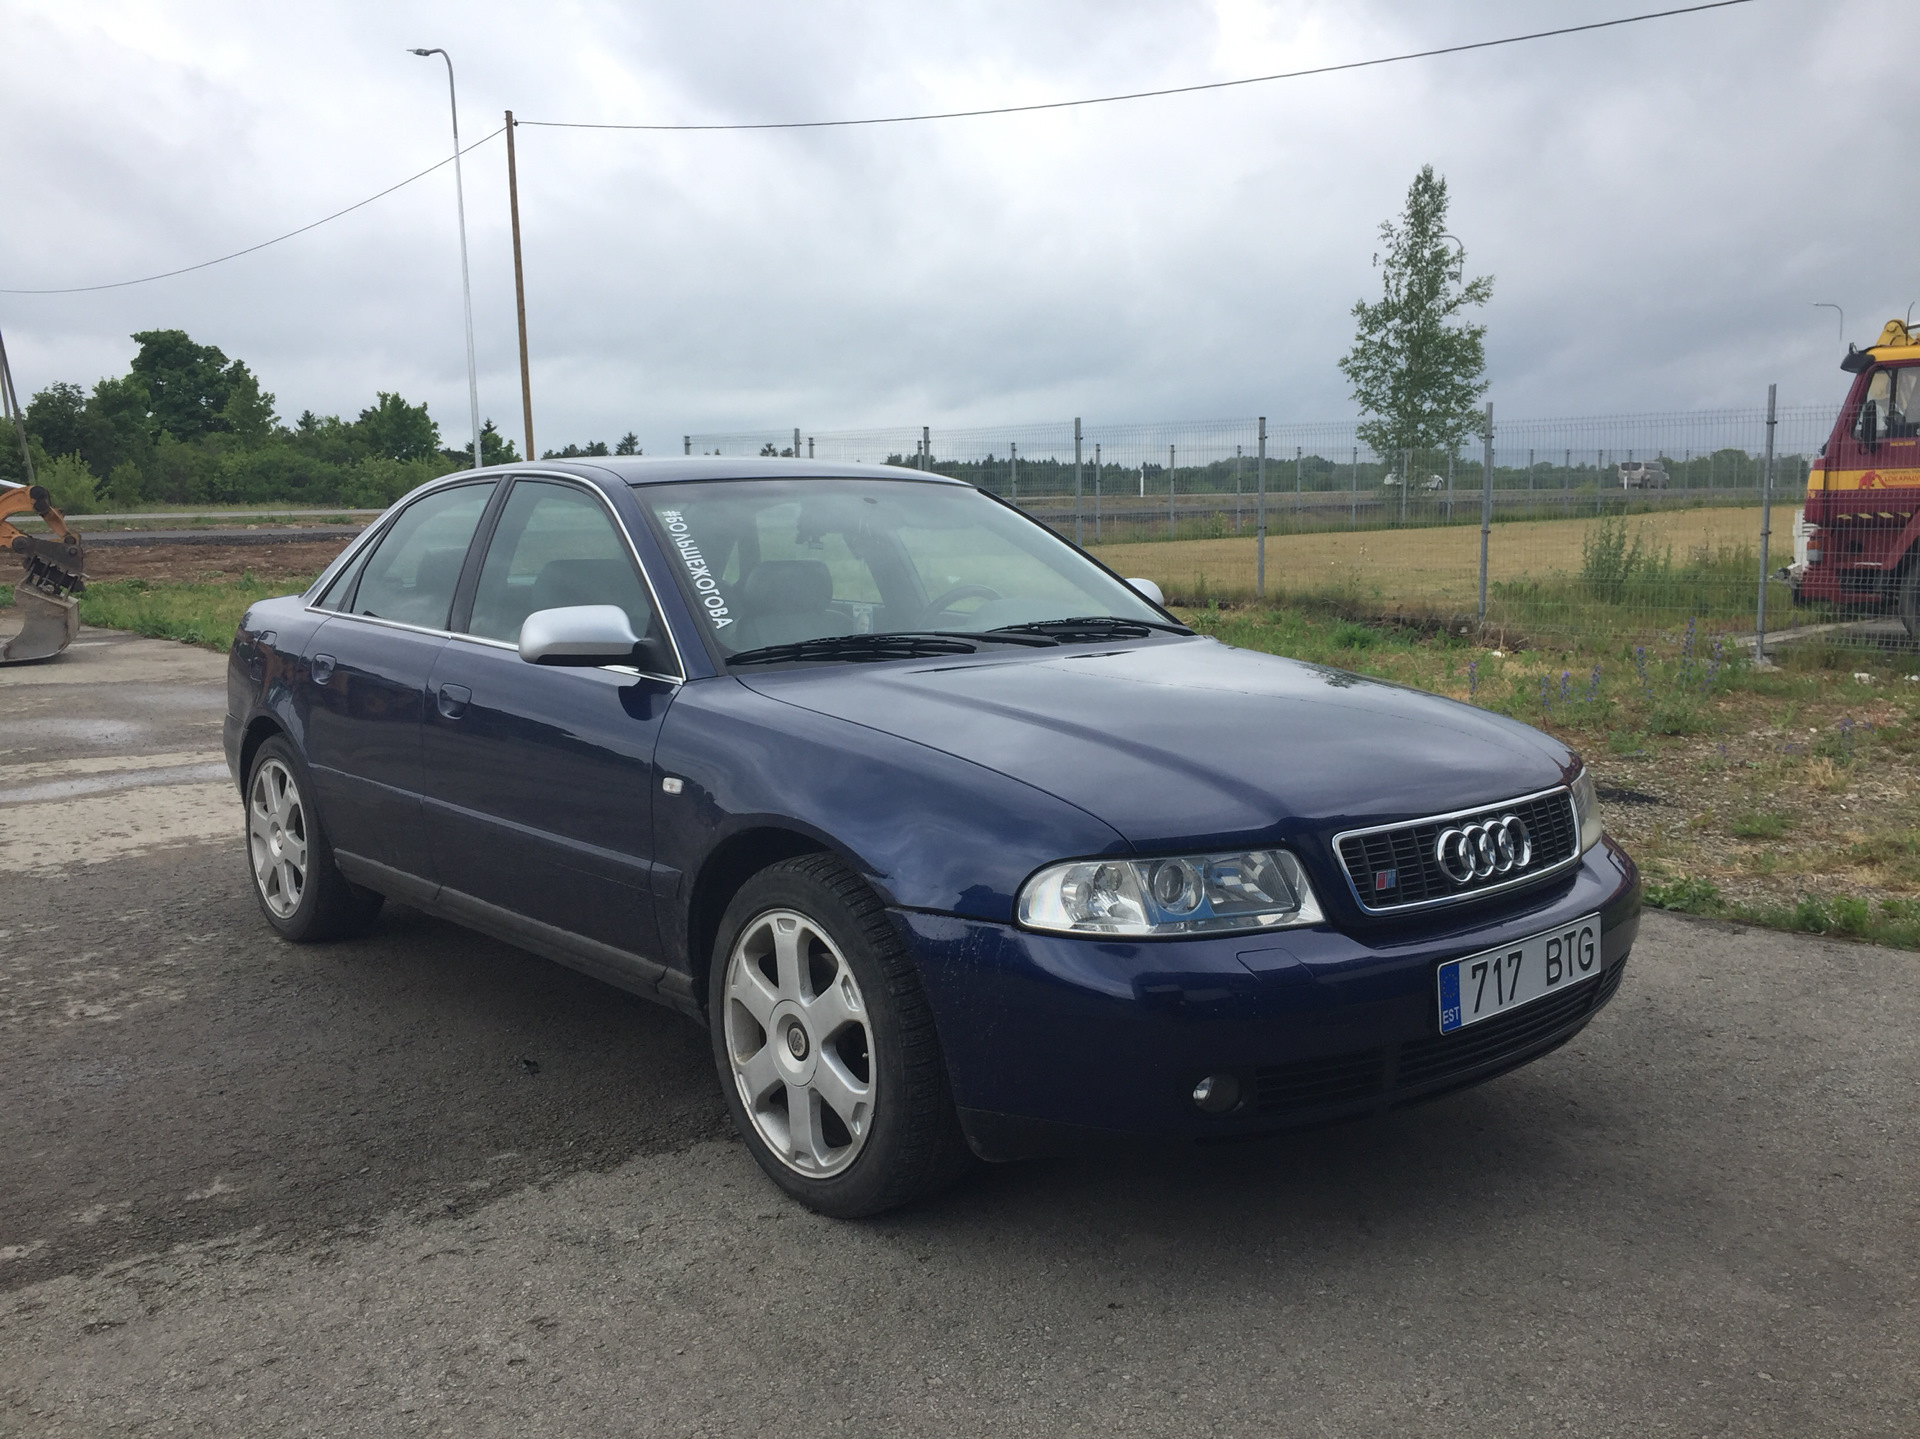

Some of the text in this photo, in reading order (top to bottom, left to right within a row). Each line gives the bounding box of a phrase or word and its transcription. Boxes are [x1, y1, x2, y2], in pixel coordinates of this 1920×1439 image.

[662, 510, 733, 629] #БОЛЬШЕЖОГОВА
[1471, 926, 1594, 1013] 717 BTG
[1442, 1006, 1459, 1024] EST
